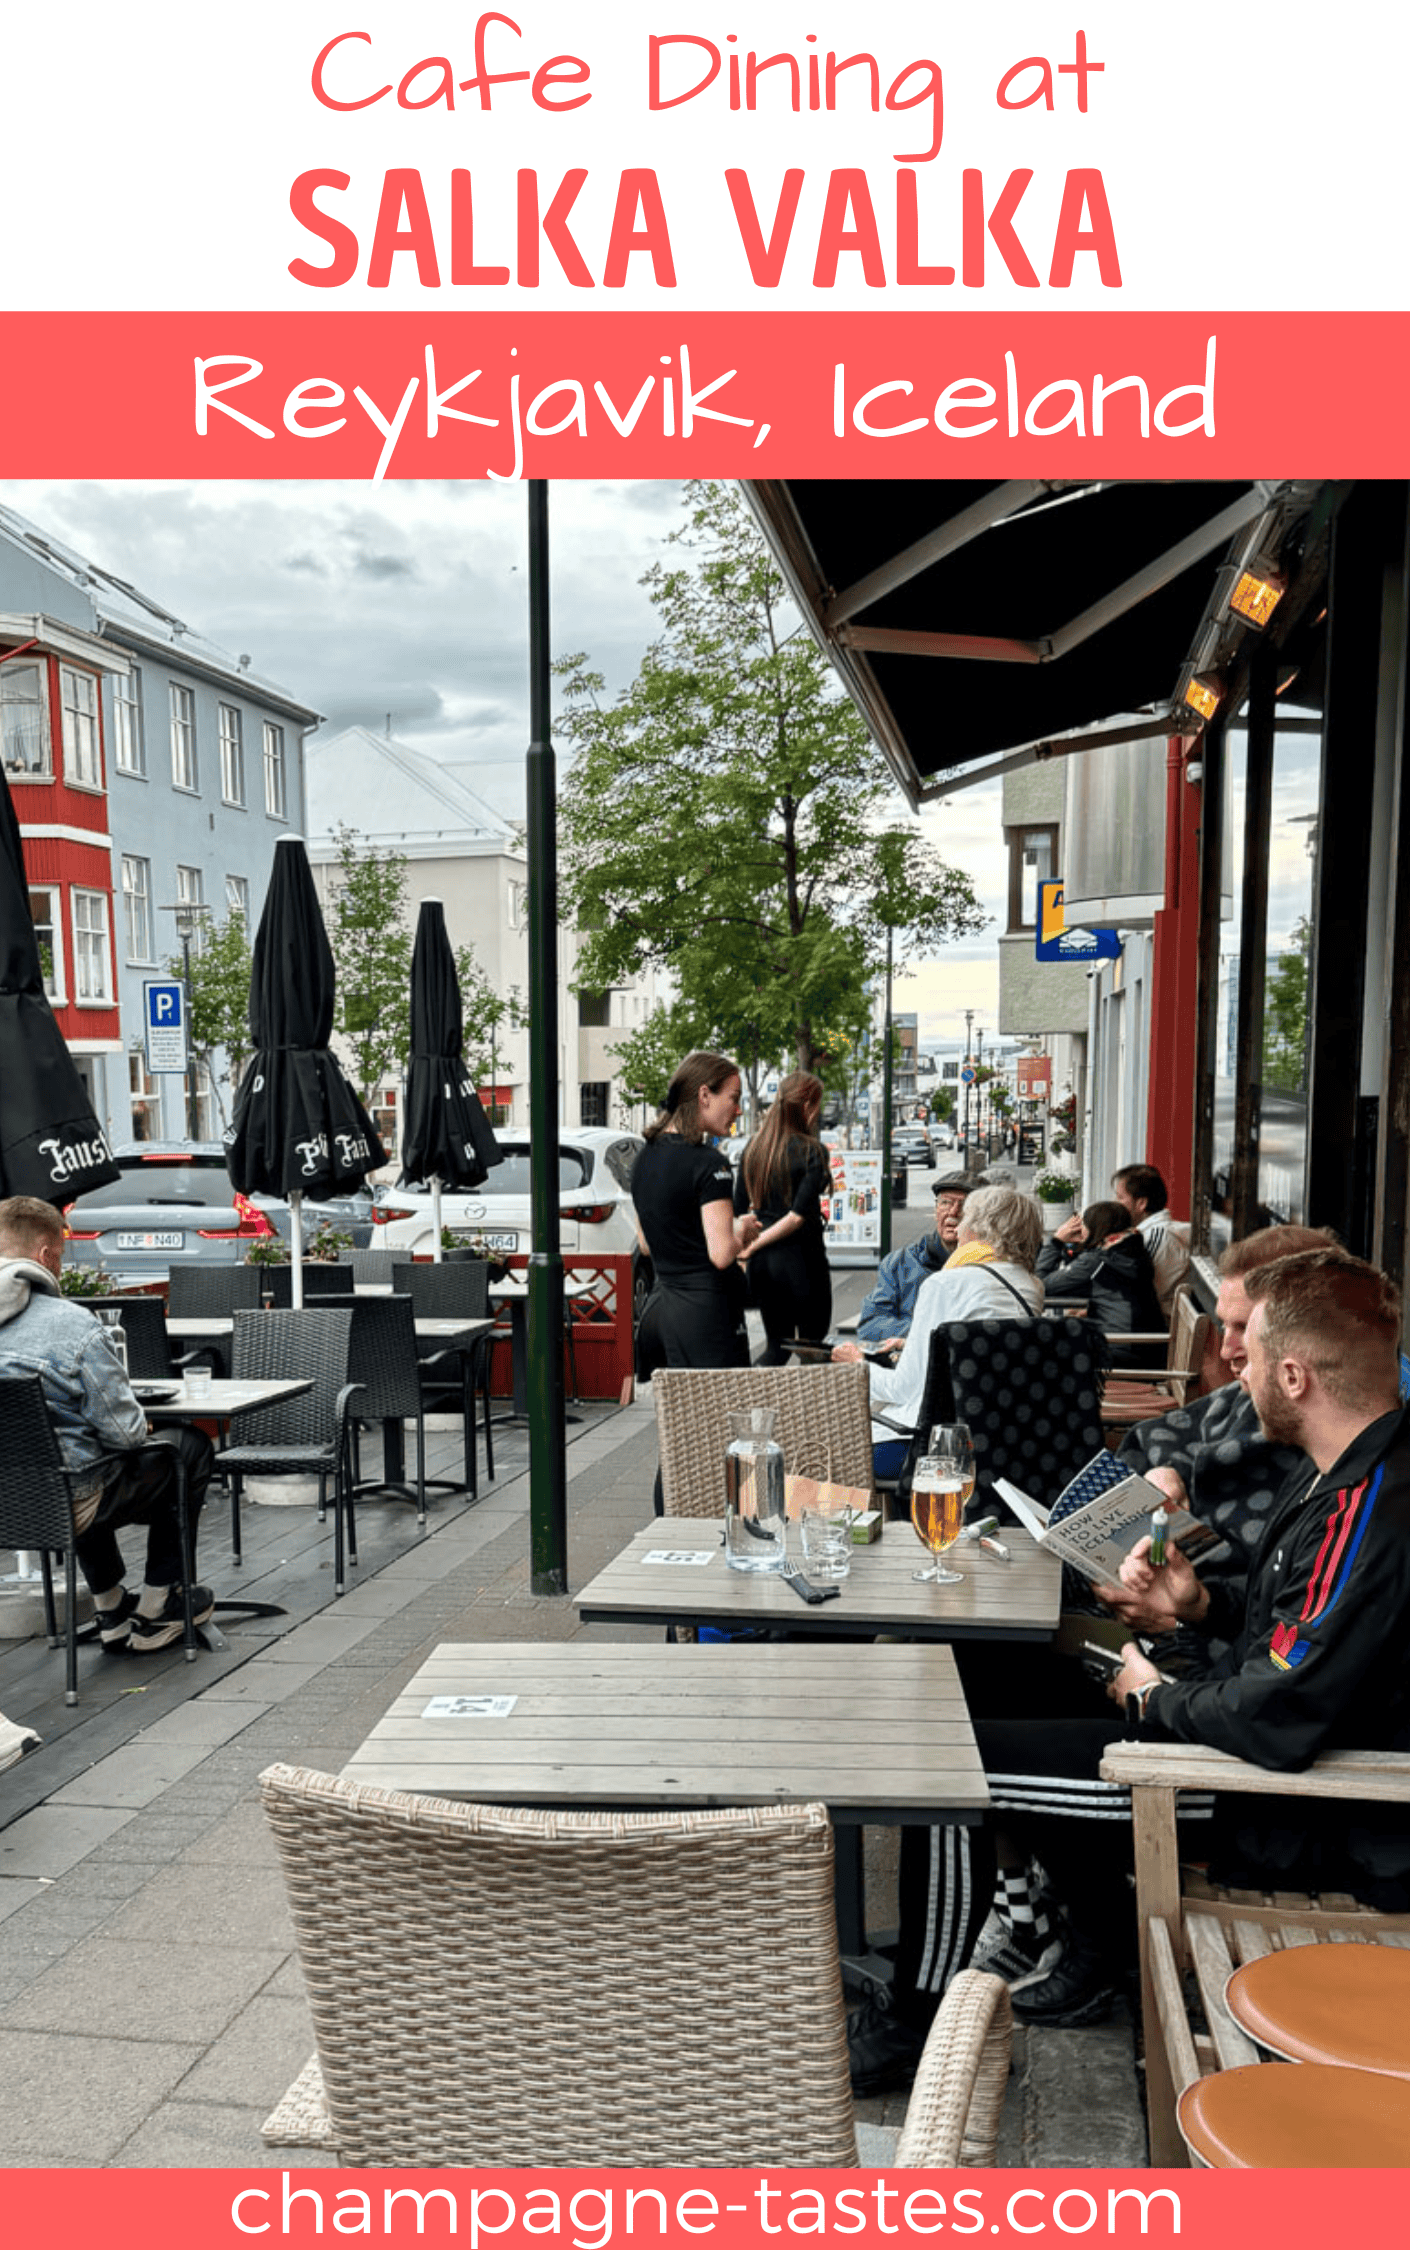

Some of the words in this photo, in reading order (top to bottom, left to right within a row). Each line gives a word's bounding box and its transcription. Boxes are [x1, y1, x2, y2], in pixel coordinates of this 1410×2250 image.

[156, 993, 173, 1020] P
[1059, 1513, 1093, 1538] HOW
[1069, 1530, 1090, 1544] TO
[1092, 1508, 1126, 1531] LIVE
[448, 1698, 493, 1714] 14
